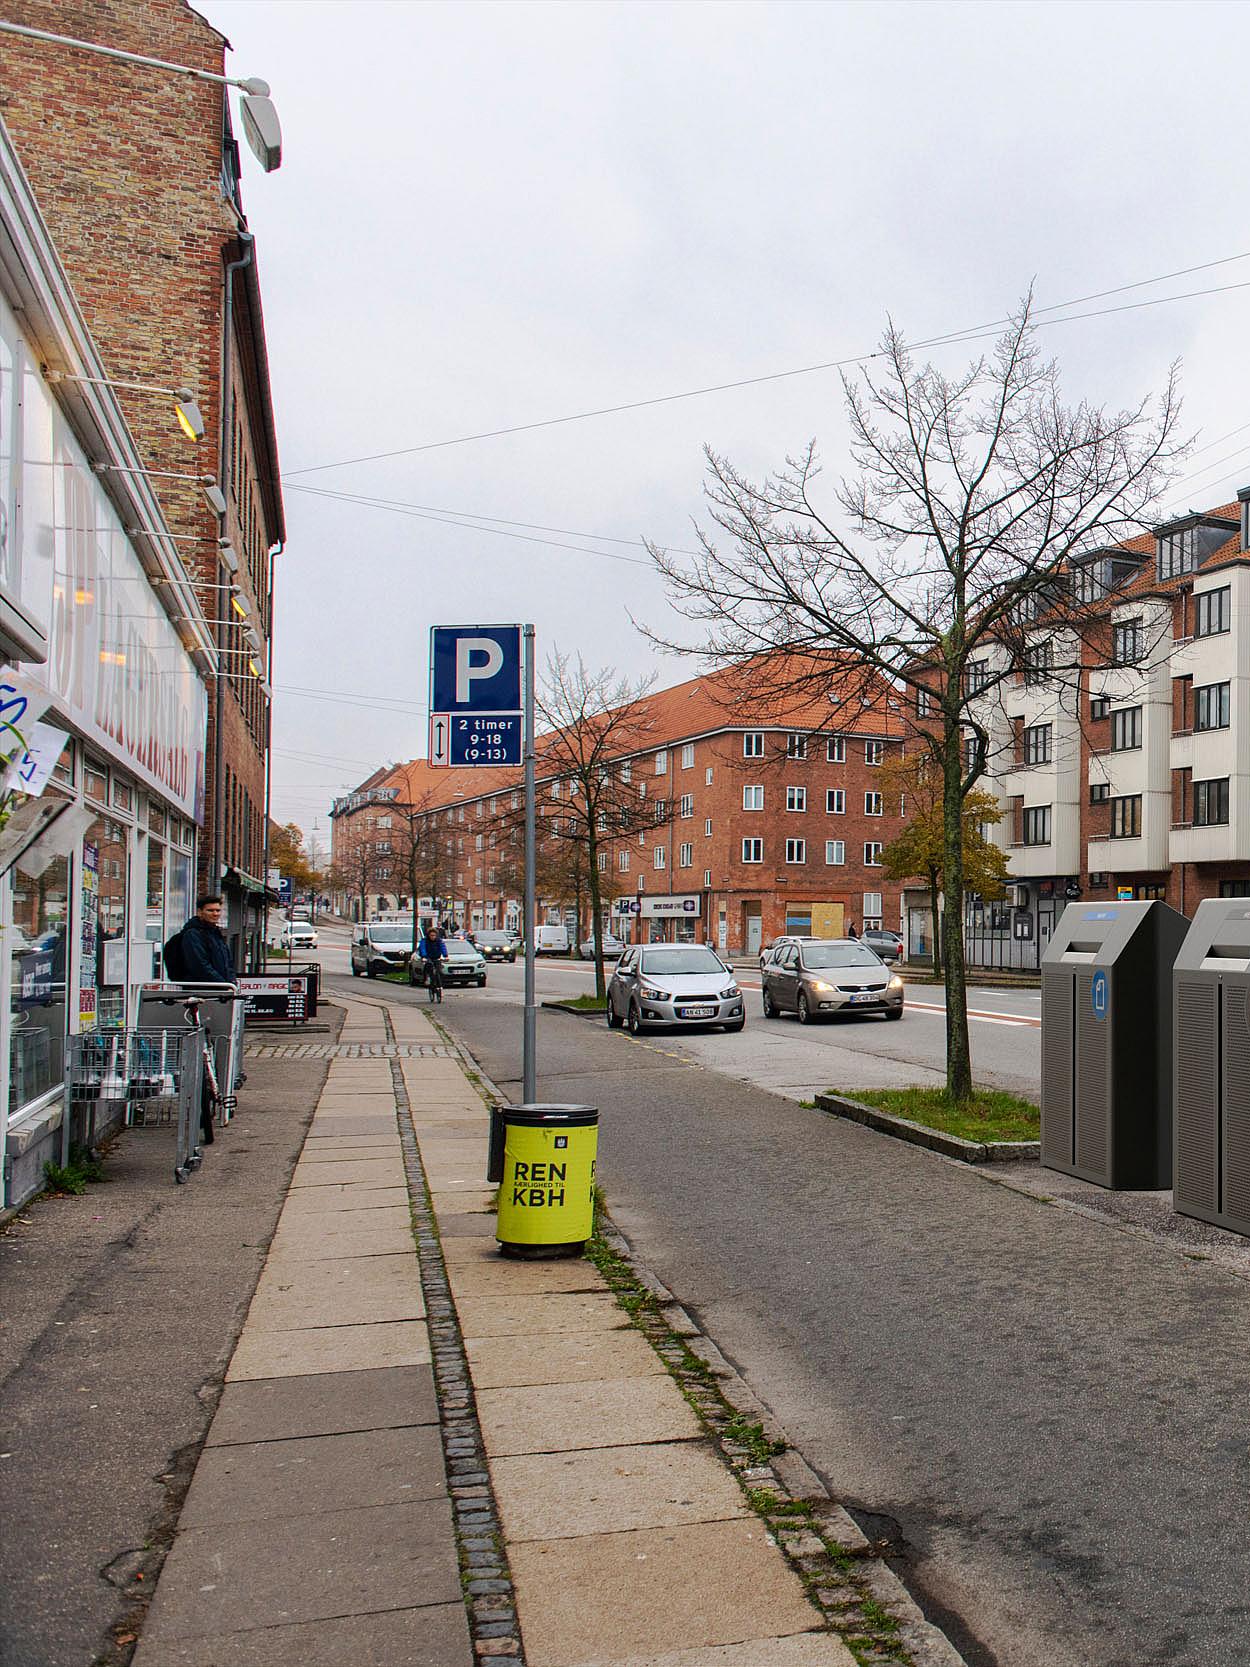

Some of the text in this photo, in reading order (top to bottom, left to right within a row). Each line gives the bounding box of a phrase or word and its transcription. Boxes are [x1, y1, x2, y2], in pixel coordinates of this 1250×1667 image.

[456, 638, 503, 702] P
[460, 720, 512, 730] 2 timer
[470, 734, 502, 745] 9-18
[464, 748, 507, 760] (9-13)
[514, 1162, 566, 1181] REN
[512, 1187, 565, 1207] KBH
